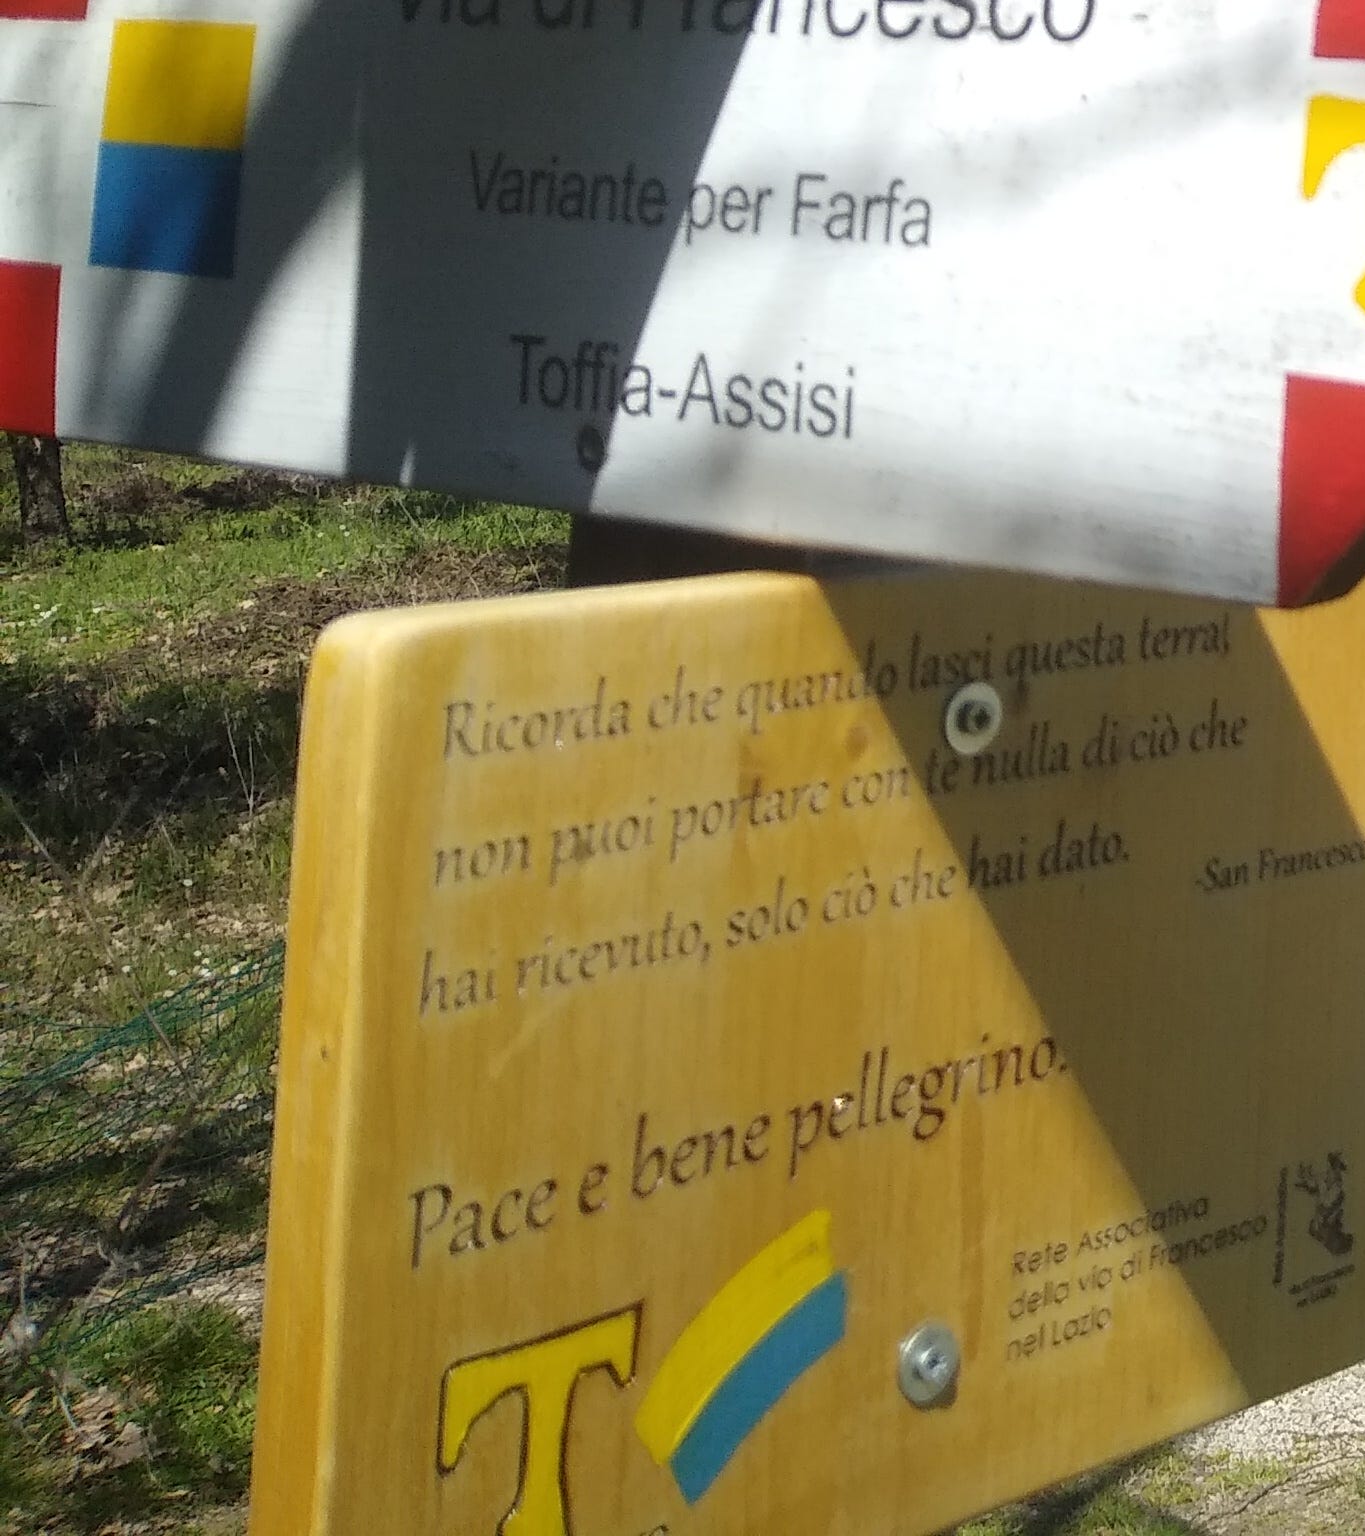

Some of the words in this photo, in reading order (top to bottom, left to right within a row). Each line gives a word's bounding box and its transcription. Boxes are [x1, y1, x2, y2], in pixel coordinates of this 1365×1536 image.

[470, 150, 667, 228] Variante
[686, 180, 773, 246] per
[792, 173, 931, 248] Farfa
[509, 334, 856, 439] Toffia-Assisi
[443, 675, 631, 760] Ricorda
[648, 664, 724, 730] che
[736, 640, 897, 735] quando
[909, 633, 993, 691] lasci
[1005, 622, 1125, 690] questa
[435, 834, 530, 888] non
[550, 796, 657, 886] puoi
[670, 776, 829, 863] portare
[841, 765, 910, 809] con
[927, 748, 958, 798] te
[971, 720, 1070, 787] nulla
[1081, 715, 1119, 768] di
[1130, 714, 1180, 763] ciò
[1189, 698, 1248, 754] che
[420, 949, 497, 1017] hai
[515, 910, 711, 995] ricevuto,
[727, 875, 808, 949] solo
[822, 867, 877, 925] ciò
[890, 846, 956, 904] che
[967, 833, 1026, 889] hai
[1039, 818, 1130, 878] dato.
[410, 1177, 557, 1270] Pace
[578, 1161, 609, 1215] e
[632, 1111, 771, 1199] bene
[787, 1032, 1068, 1183] pellegrino.
[1008, 1276, 1070, 1321] della
[1077, 1265, 1112, 1293] via
[1121, 1252, 1142, 1282] di
[1149, 1213, 1268, 1270] Francesco
[1011, 1241, 1068, 1276] Rete
[1077, 1196, 1208, 1255] Associativa
[1005, 1322, 1045, 1360] nel
[1052, 1305, 1112, 1347] Lazio
